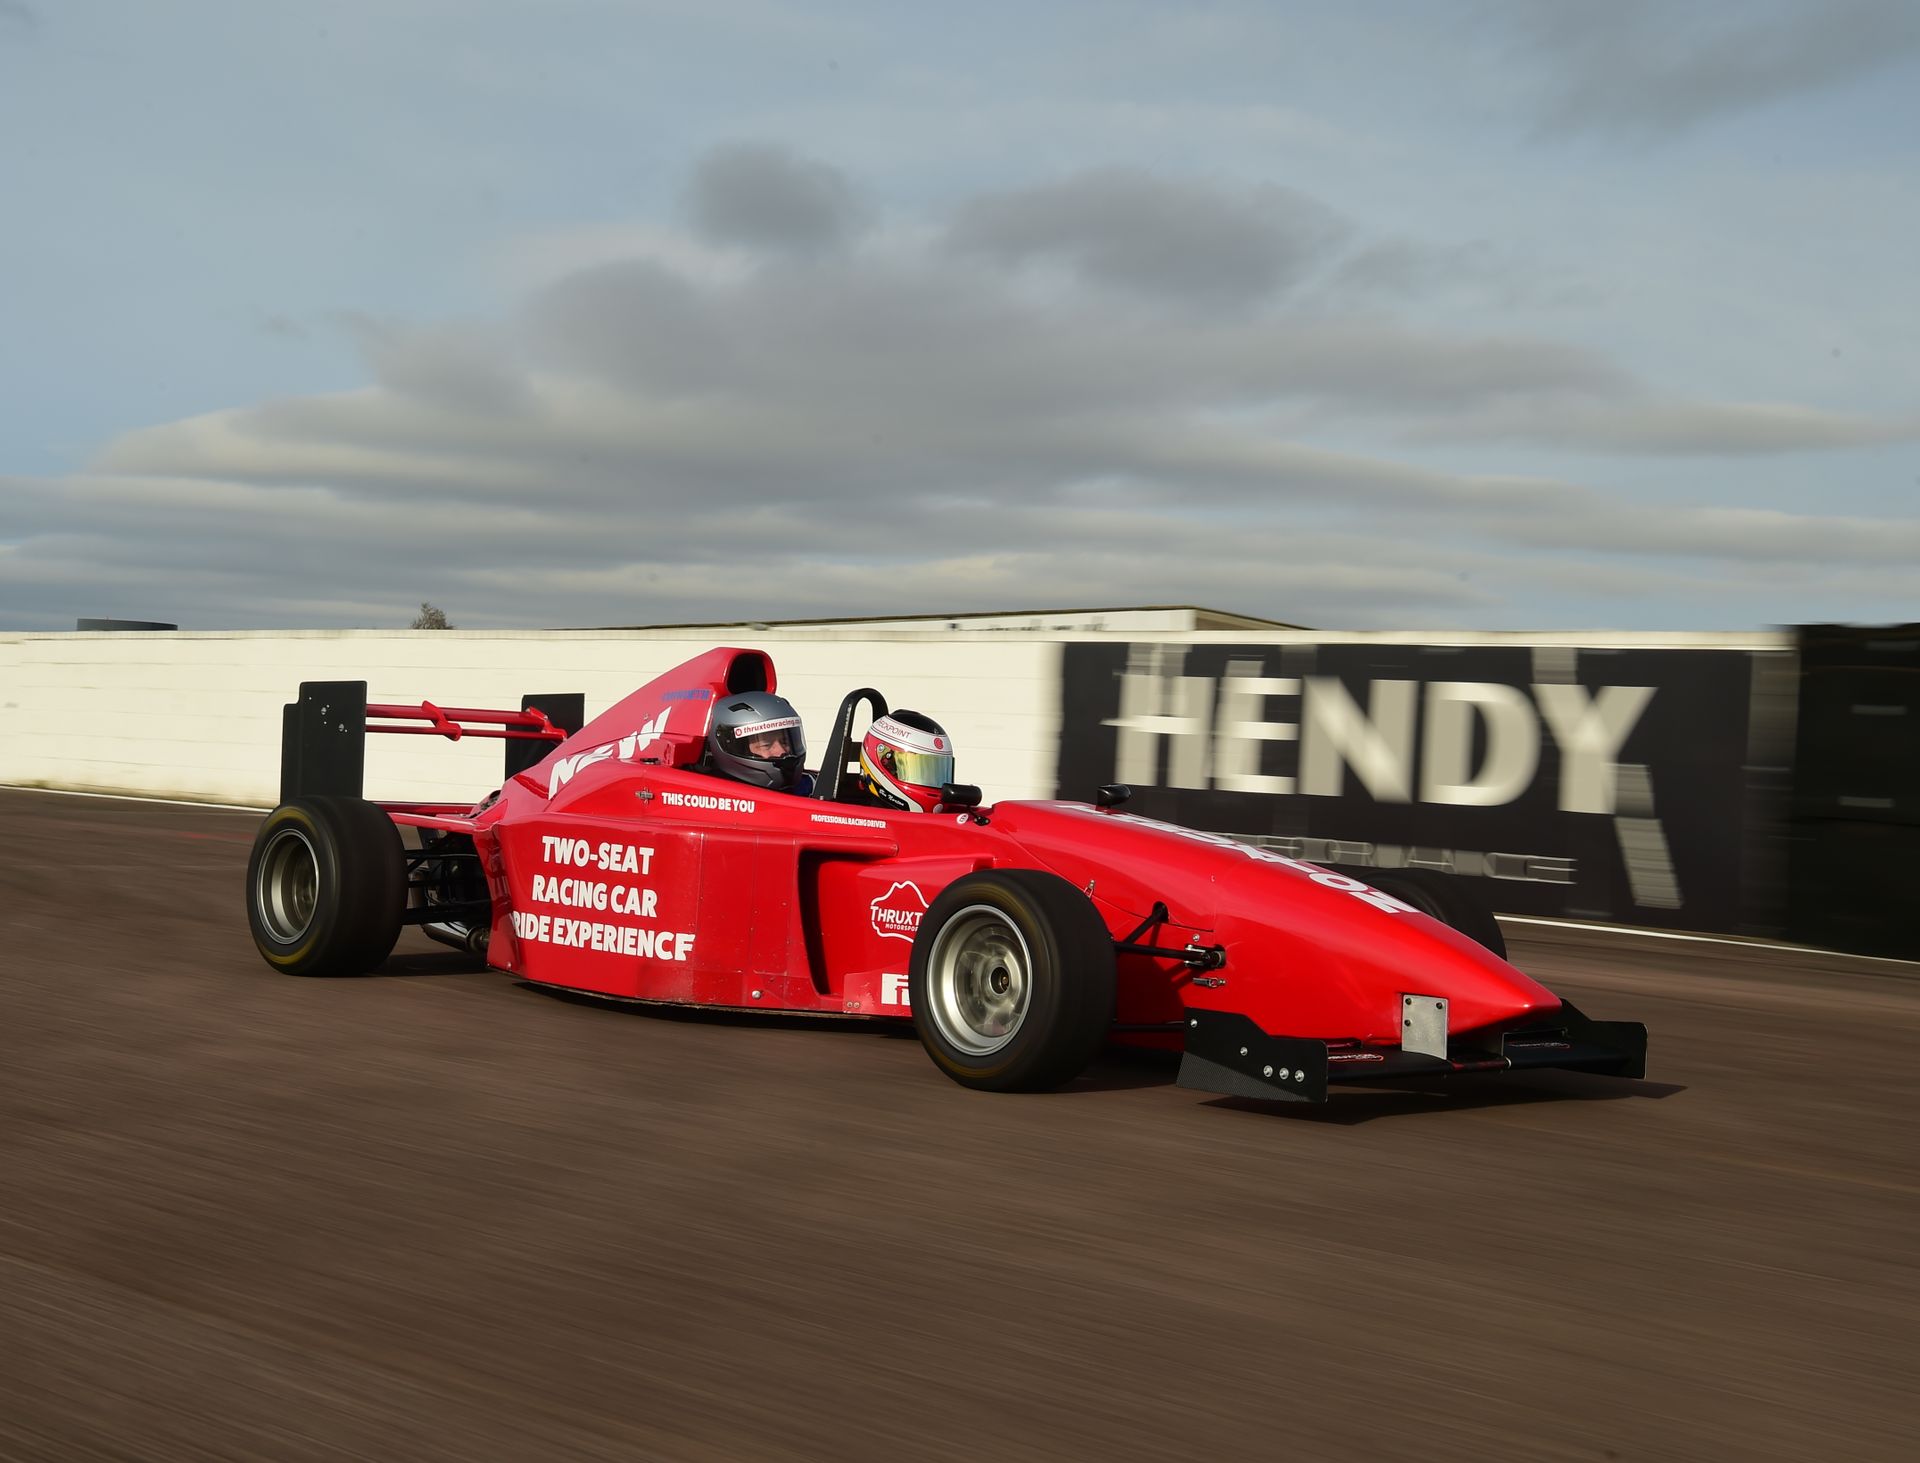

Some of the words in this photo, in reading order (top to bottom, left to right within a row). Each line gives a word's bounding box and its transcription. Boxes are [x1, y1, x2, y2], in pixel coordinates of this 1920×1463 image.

[548, 706, 671, 800] NEW
[1113, 674, 1658, 815] HENDY
[661, 792, 683, 806] THIS
[685, 794, 717, 809] COULD
[718, 798, 731, 811] BE
[731, 800, 755, 813] YOU
[542, 835, 654, 875] TWO-SEAT
[532, 874, 608, 911] RACING
[610, 885, 658, 918] CAR
[870, 905, 923, 926] THRUXT
[512, 910, 550, 943] RIDE
